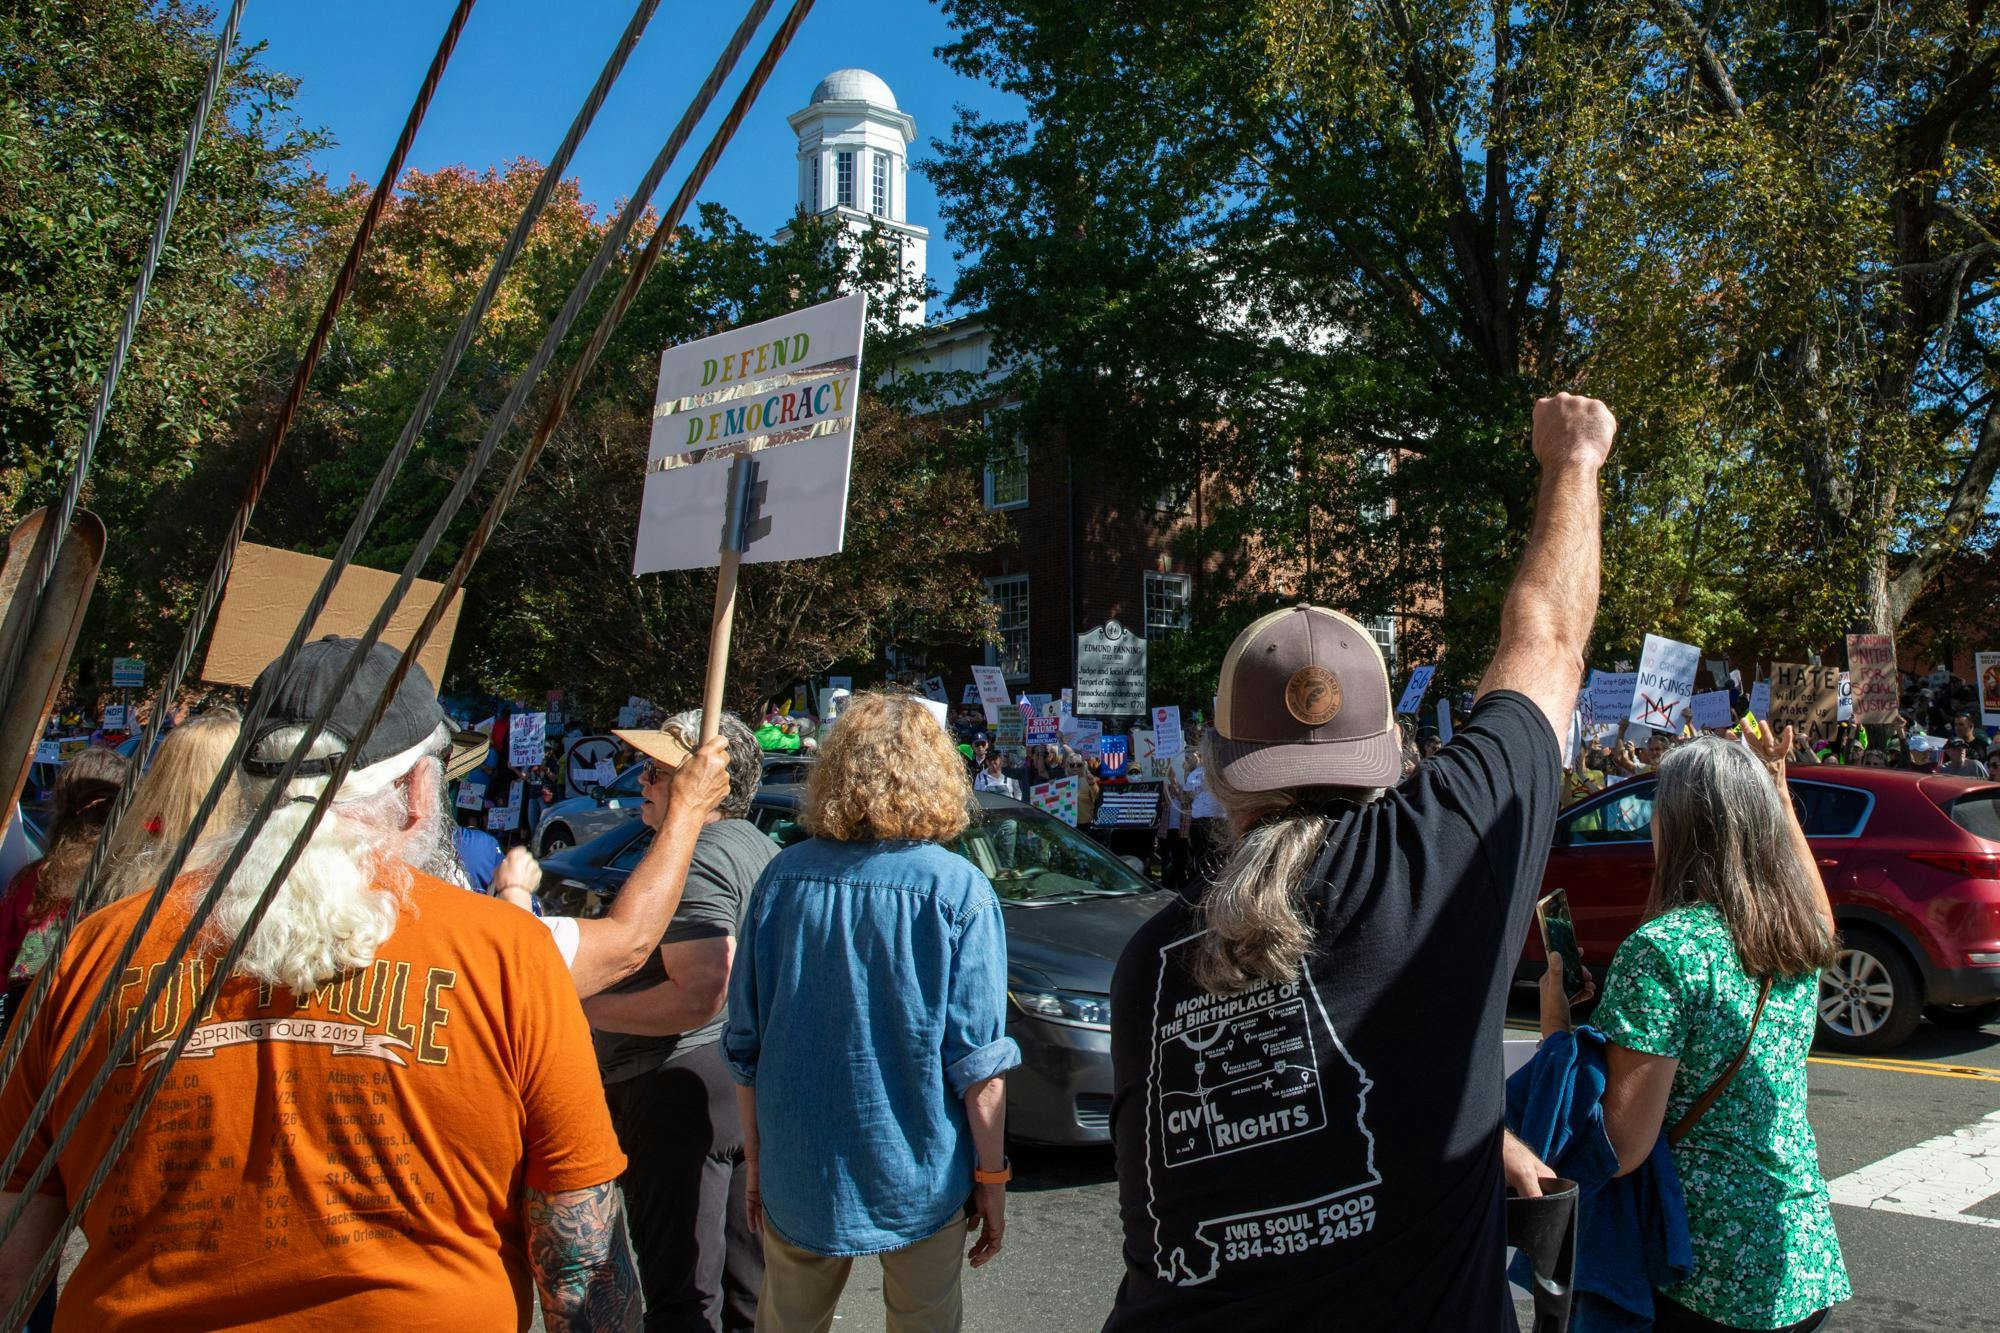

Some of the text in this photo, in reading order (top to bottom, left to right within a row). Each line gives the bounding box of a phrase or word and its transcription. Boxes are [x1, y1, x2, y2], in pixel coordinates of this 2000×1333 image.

[701, 332, 810, 386] DEFEND
[686, 377, 850, 445] DEMOCRACY
[1848, 635, 1890, 645] STANDING
[1084, 644, 1143, 655] EDMUND FANNING
[1850, 649, 1891, 664] UNITED
[1079, 666, 1095, 676] Judge
[1097, 667, 1108, 675] and
[1110, 666, 1123, 675] local
[1778, 667, 1835, 689] HATE
[1860, 668, 1886, 680] FOR
[1079, 678, 1097, 688] Target
[1099, 678, 1104, 686] of
[1411, 670, 1430, 690] 86
[1640, 672, 1656, 687] NO
[1660, 677, 1692, 697] KINGS
[1776, 690, 1818, 702] will not
[1852, 683, 1892, 696] SOCIAL
[1088, 701, 1109, 710] nearby
[1402, 695, 1421, 711] 47
[1856, 699, 1898, 715] JUSTICE
[1815, 709, 1827, 717] us
[514, 717, 535, 728] WAKE
[1033, 718, 1054, 726] STOP
[1773, 719, 1834, 739] GREAT
[1029, 725, 1057, 734] TRUMP
[517, 756, 536, 764] LIAR
[1160, 981, 1300, 1039] THE BIRTHPLACE OF
[190, 1021, 358, 1047] SPRING TOUR 2019
[184, 1074, 199, 1089] CO
[327, 1070, 369, 1086] Athens,
[373, 1071, 390, 1084] GA
[1280, 1085, 1303, 1095] ALABAMA
[326, 1090, 369, 1106] Athens,
[372, 1090, 388, 1105] GA
[368, 1113, 385, 1126] GA
[1168, 1102, 1224, 1134] CIVIL
[1215, 1105, 1309, 1147] RIGHTS
[396, 1153, 410, 1167] NC
[410, 1172, 422, 1186] FL
[425, 1191, 436, 1205] FL
[265, 1216, 290, 1230] 5/3
[1224, 1195, 1375, 1241] JWB SOUL FOOD
[265, 1235, 289, 1250] 5/4
[325, 1233, 350, 1247] New
[1225, 1210, 1377, 1261] 334-313-2457
